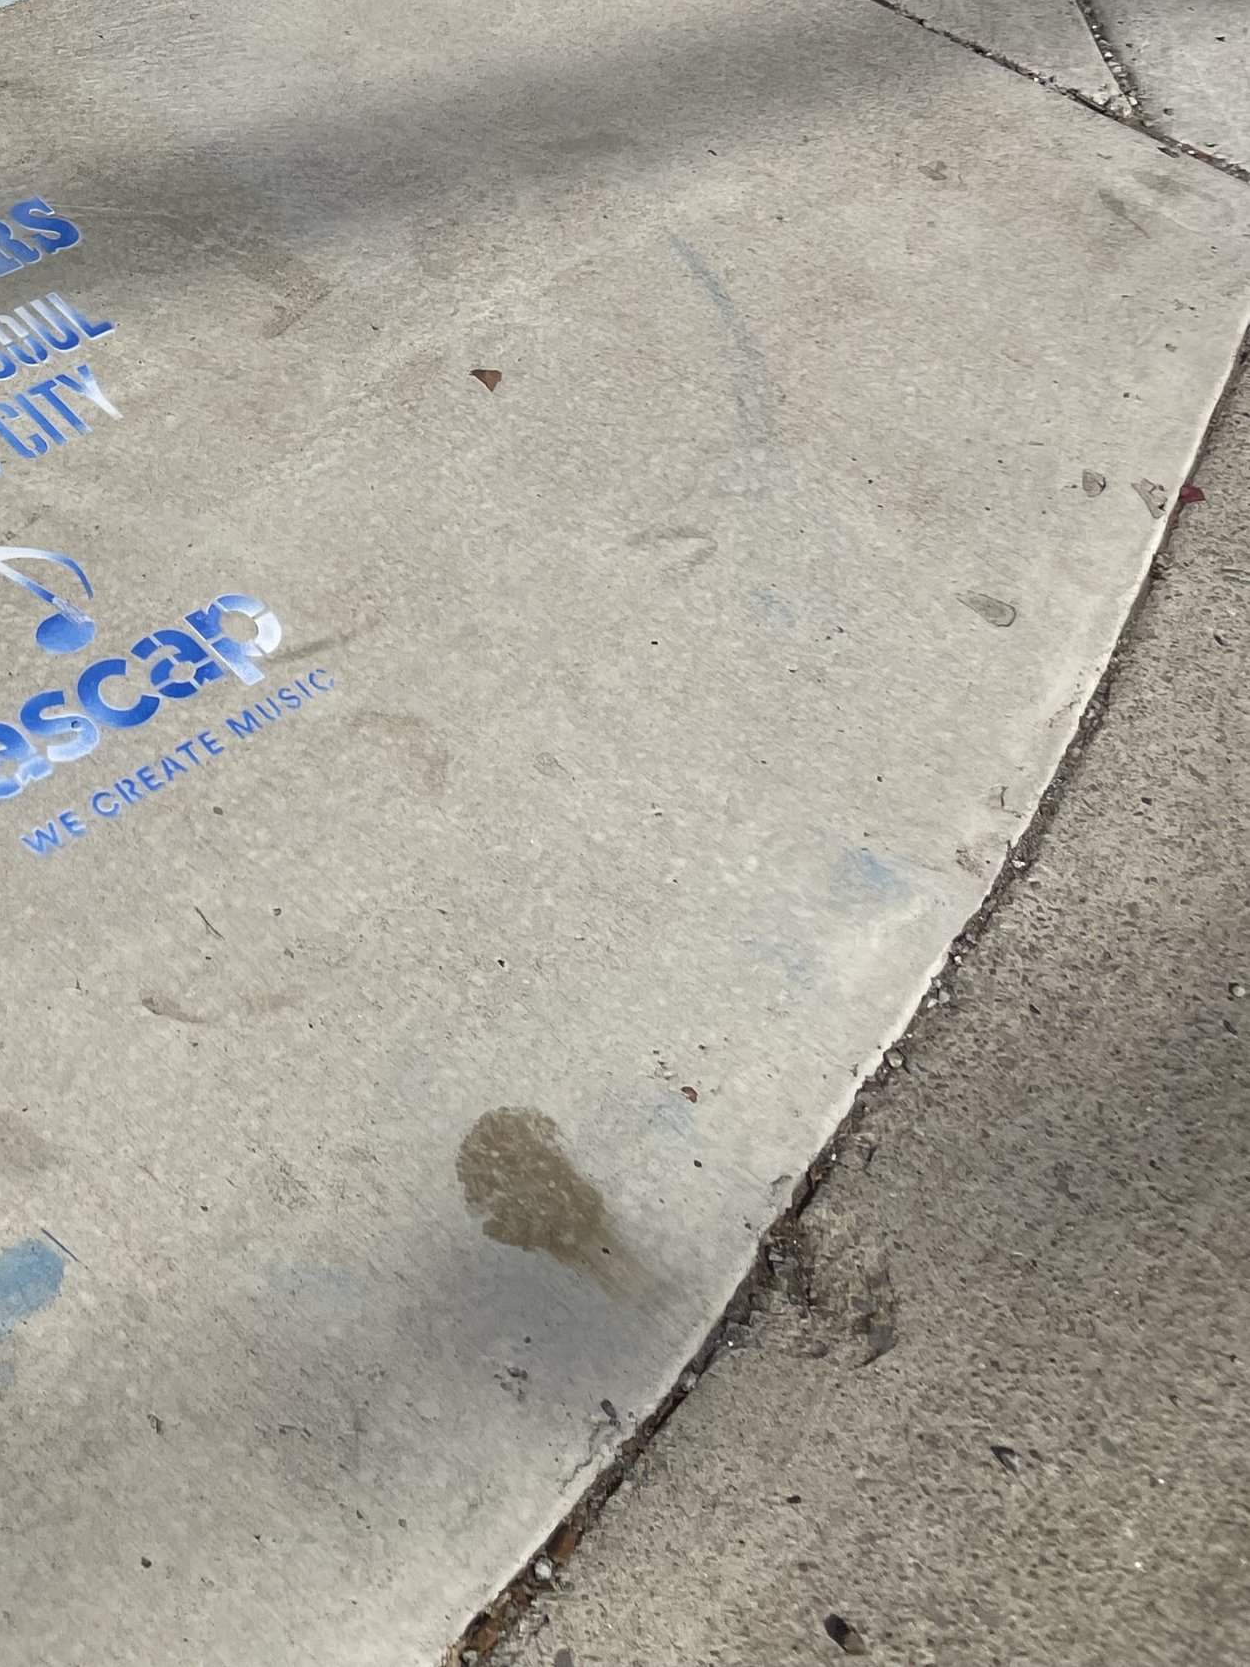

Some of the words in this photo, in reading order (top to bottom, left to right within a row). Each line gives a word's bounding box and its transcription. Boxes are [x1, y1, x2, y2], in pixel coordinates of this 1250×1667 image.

[20, 809, 86, 856] WE
[91, 729, 226, 819] CREATE
[226, 666, 336, 740] MUSIC
